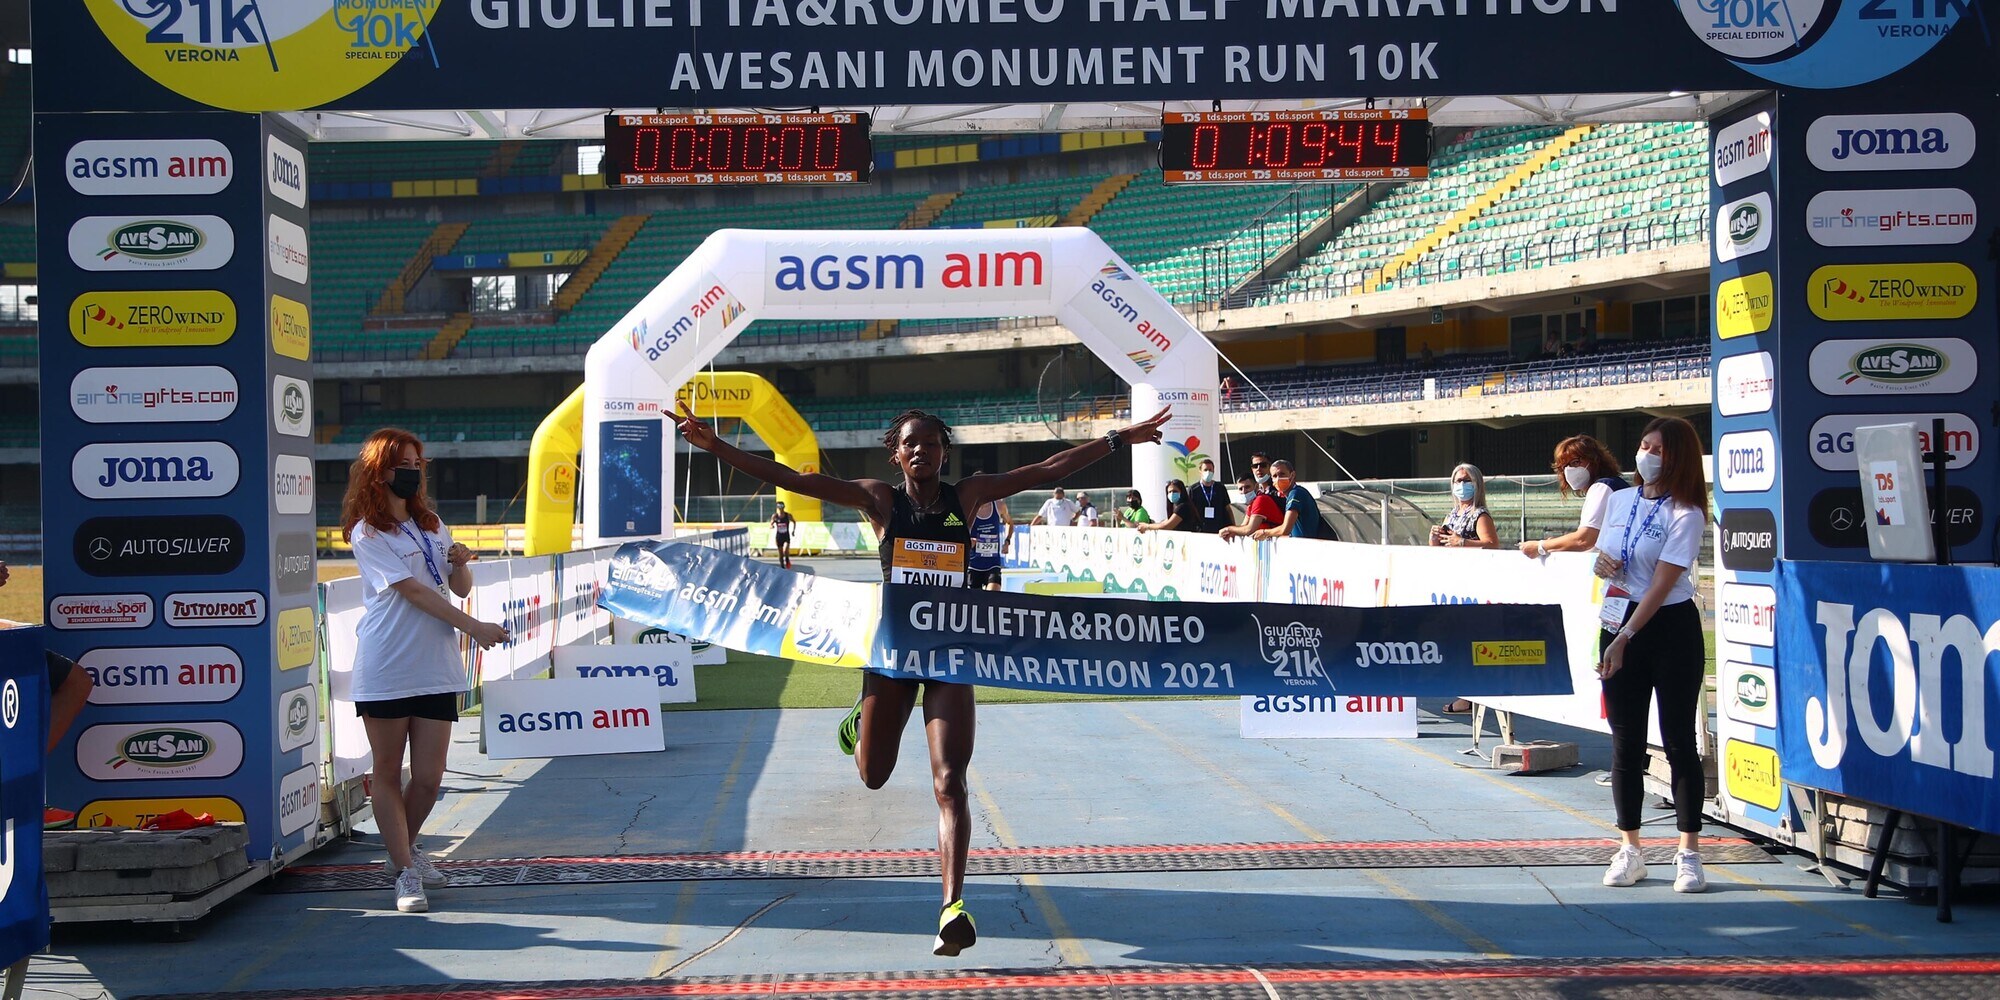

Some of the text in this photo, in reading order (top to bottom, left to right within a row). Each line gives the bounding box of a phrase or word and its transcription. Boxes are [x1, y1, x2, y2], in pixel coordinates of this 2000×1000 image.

[349, 13, 420, 47] 10k
[1706, 31, 1784, 40] SPECIAL EDITION
[164, 49, 239, 61] VERONA
[345, 51, 382, 60] SPECIAL
[670, 42, 1439, 91] AVESANI MONUMENT RUN 10K
[623, 114, 851, 126] TDS tds.sport TDS tds.sport TDS tds.sport TDS
[1181, 110, 1409, 122] TDS tds.sport TDS tds.sport TDS tds.sport TDS
[168, 155, 227, 177] aim
[1183, 168, 1410, 180] TDS tds.sport TDS tds.sport TDS tds.sport TDS
[625, 172, 852, 184] TDS tds.sport TDS tds.sport TDS tds.sport TDS
[1813, 211, 1973, 231] aironegifts.com
[120, 227, 194, 250] AVESANI
[775, 251, 1043, 291] aGsm aim
[1137, 320, 1172, 352] aim
[1861, 350, 1937, 373] AVESANI
[77, 388, 235, 408] aironegifts.com
[675, 382, 750, 401] EROWIND
[1918, 431, 1972, 452] am
[1875, 473, 1894, 490] TDS
[120, 538, 230, 556] AUTOSILVER
[1730, 531, 1771, 550] AUTOSILVER
[57, 601, 146, 617] Corriere dello Sport
[173, 599, 257, 616] TUTTOSPORT
[909, 601, 1205, 643] GIULIETTA&ROMEO
[1265, 626, 1322, 638] GIULIETTA
[1281, 636, 1320, 648] ROMEO
[178, 663, 236, 685] aim
[883, 648, 1235, 688] HALF MARATHON 2021
[1273, 651, 1323, 678] 21k
[499, 707, 650, 733] aGsm aim
[129, 735, 203, 758] AVESANI
